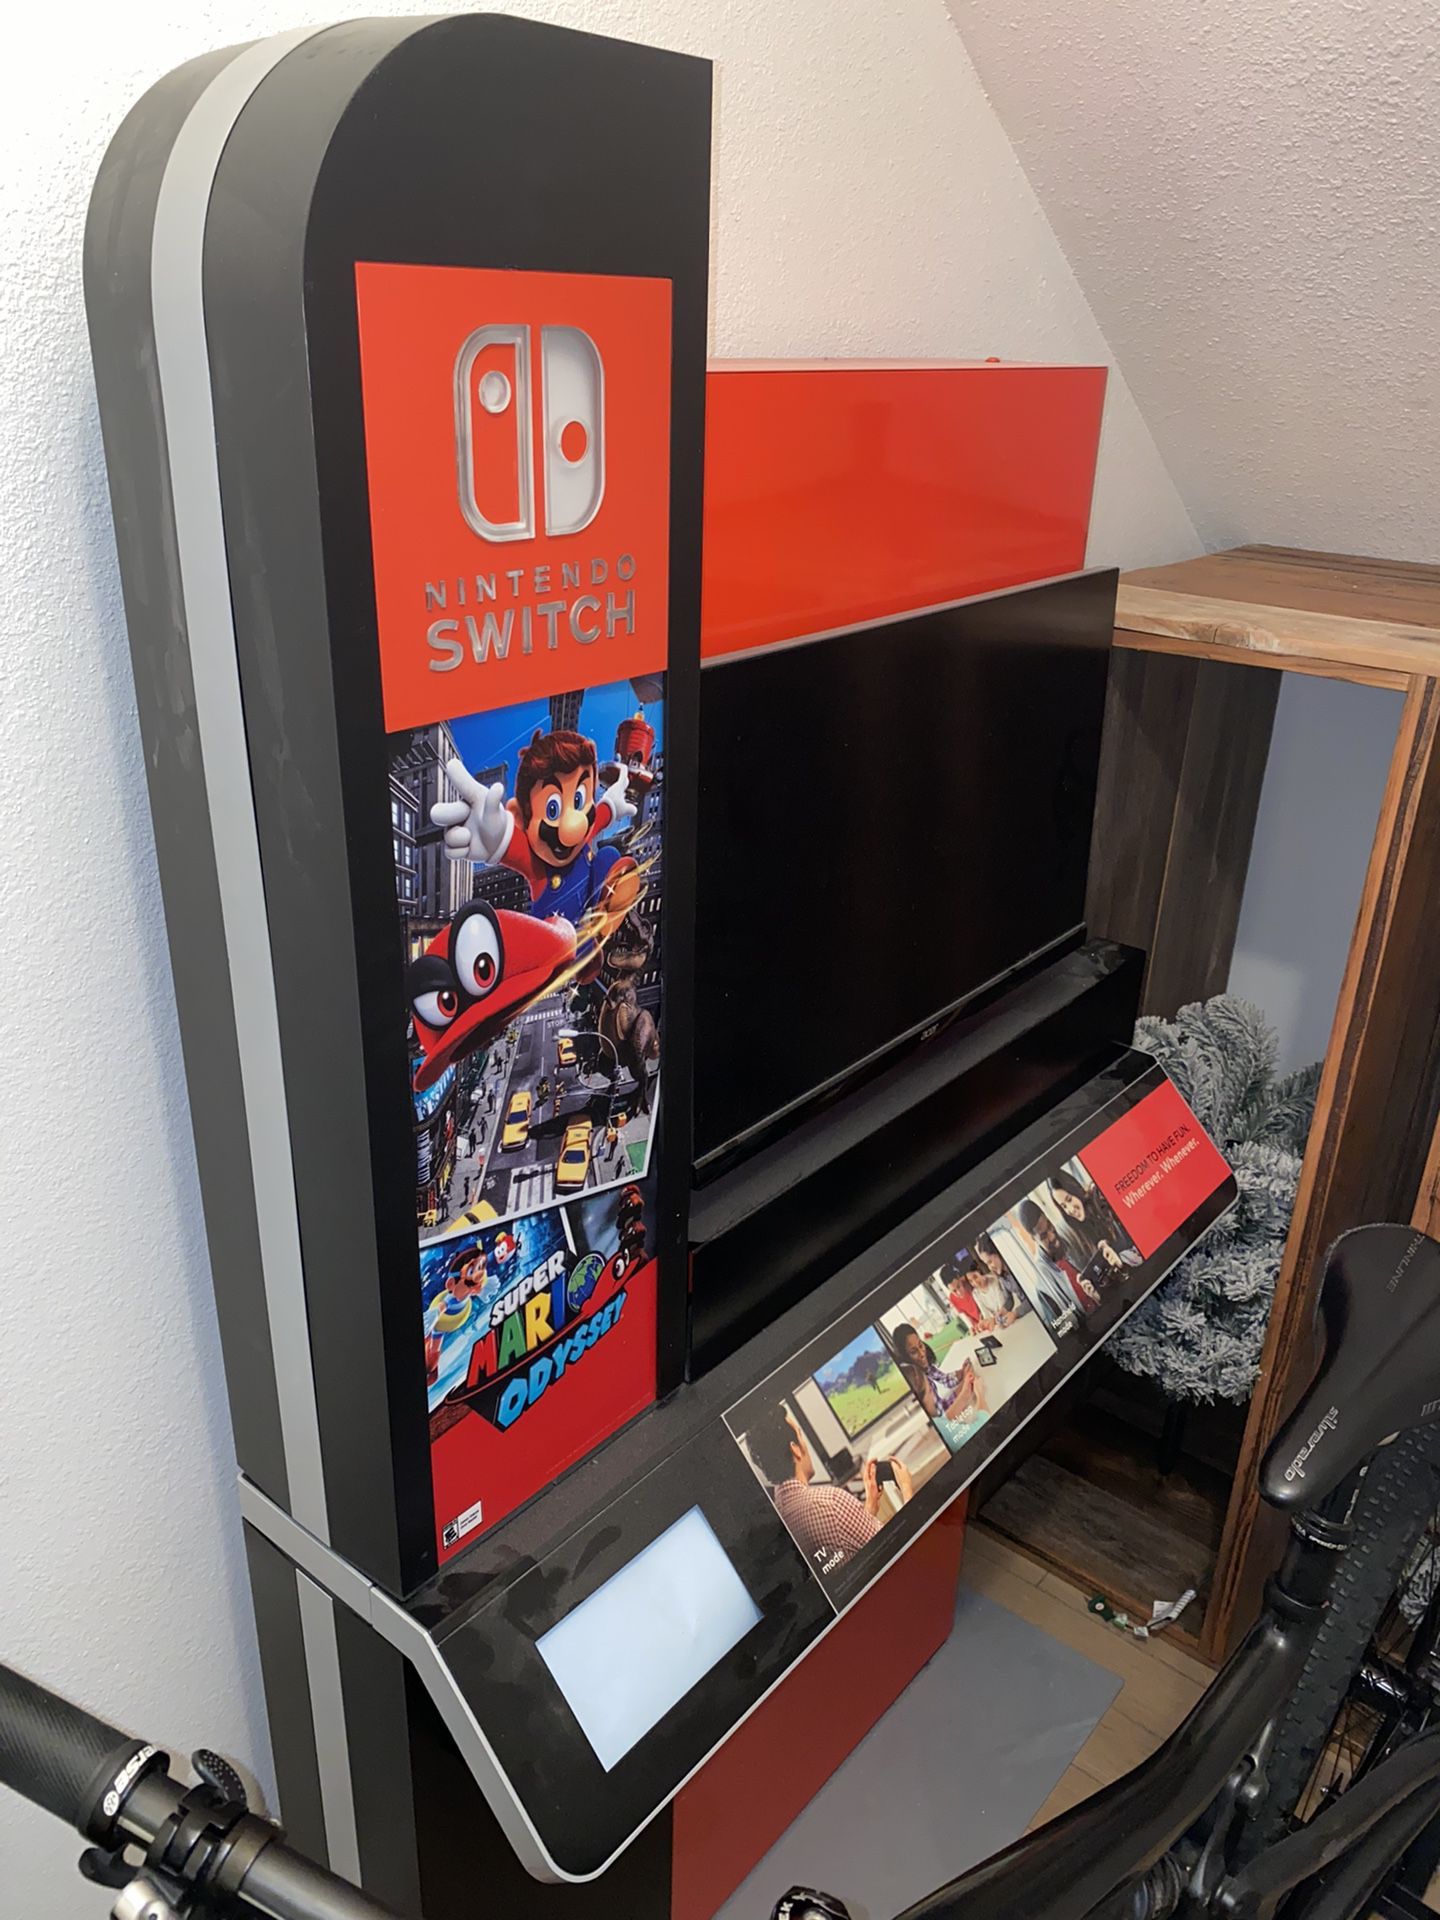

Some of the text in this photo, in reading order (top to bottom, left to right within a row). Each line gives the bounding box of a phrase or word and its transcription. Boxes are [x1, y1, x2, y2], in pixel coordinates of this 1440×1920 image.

[425, 553, 636, 611] NINTENDO
[426, 589, 636, 672] SWITCH
[1114, 1159, 1150, 1194] FREEDOM
[1146, 1151, 1160, 1164] TO
[1156, 1135, 1177, 1157] HAVE
[1122, 1137, 1200, 1209] Wherever. Whenever.
[491, 1250, 566, 1326] SUPER
[497, 1292, 627, 1428] ODYSSEY
[1284, 1406, 1339, 1482] silverado
[813, 1546, 827, 1563] TV
[822, 1550, 844, 1575] mode
